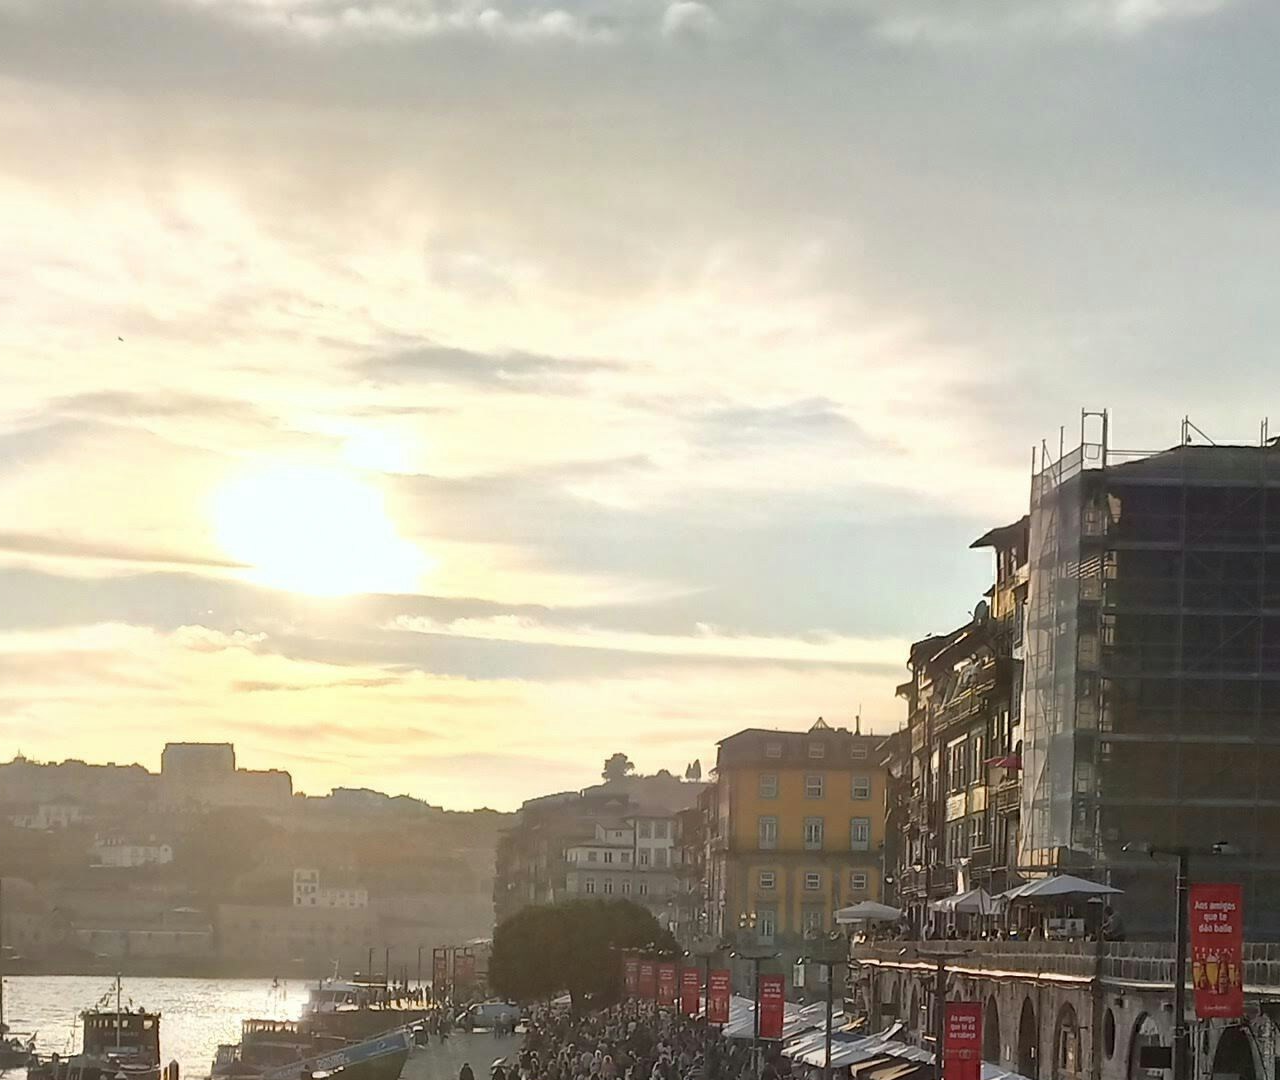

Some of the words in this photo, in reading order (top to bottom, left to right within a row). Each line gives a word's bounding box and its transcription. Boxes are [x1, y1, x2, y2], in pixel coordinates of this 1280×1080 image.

[1194, 901, 1208, 910] Aos
[1209, 901, 1236, 912] amigos
[1203, 913, 1218, 923] que
[1219, 912, 1227, 921] te
